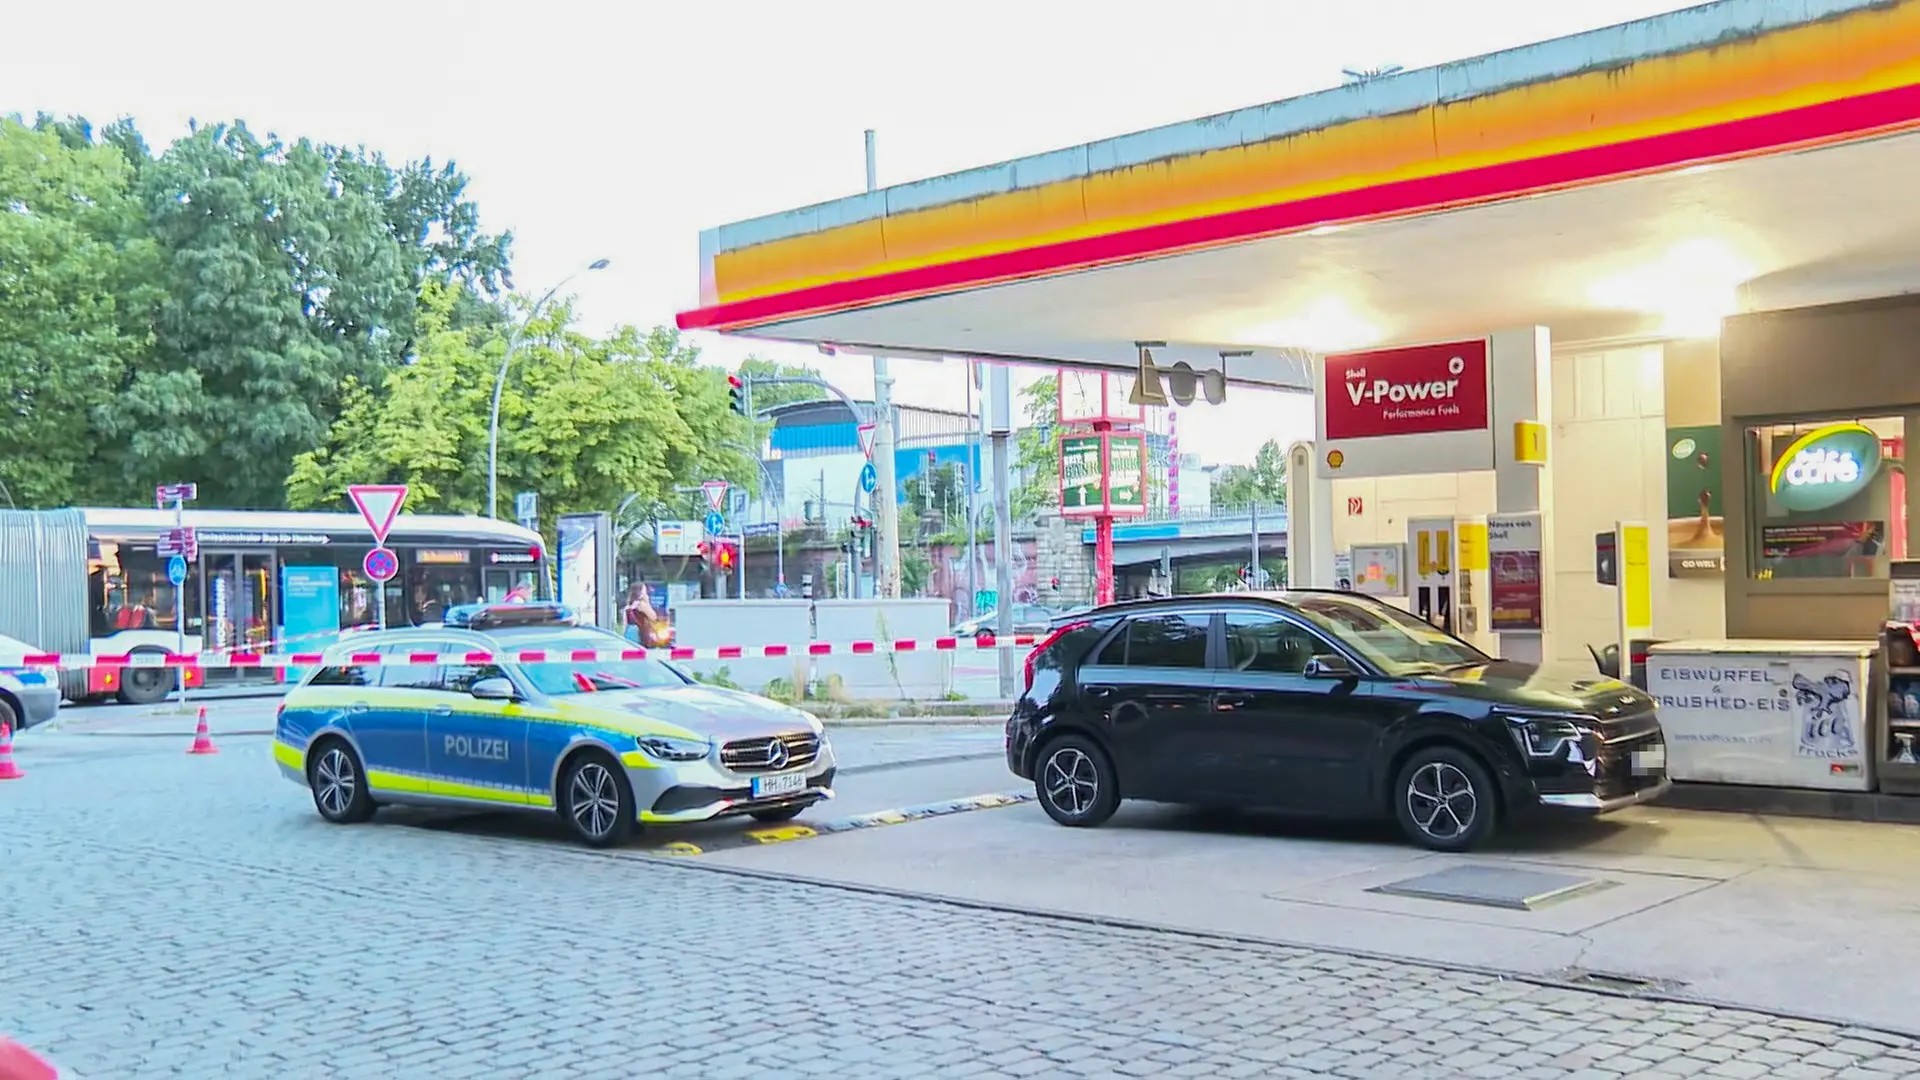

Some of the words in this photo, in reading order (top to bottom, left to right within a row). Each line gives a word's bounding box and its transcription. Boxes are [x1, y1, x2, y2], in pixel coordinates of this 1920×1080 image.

[1345, 368, 1366, 379] Shell
[1345, 379, 1459, 406] V-Power
[1383, 407, 1436, 420] Performance
[1438, 404, 1460, 416] Fuels
[1489, 519, 1514, 528] Neues
[1681, 560, 1696, 568] GO
[1696, 560, 1716, 568] WELL
[1661, 667, 1775, 682] EISWÜRFEL
[444, 734, 510, 760] POLIZEI
